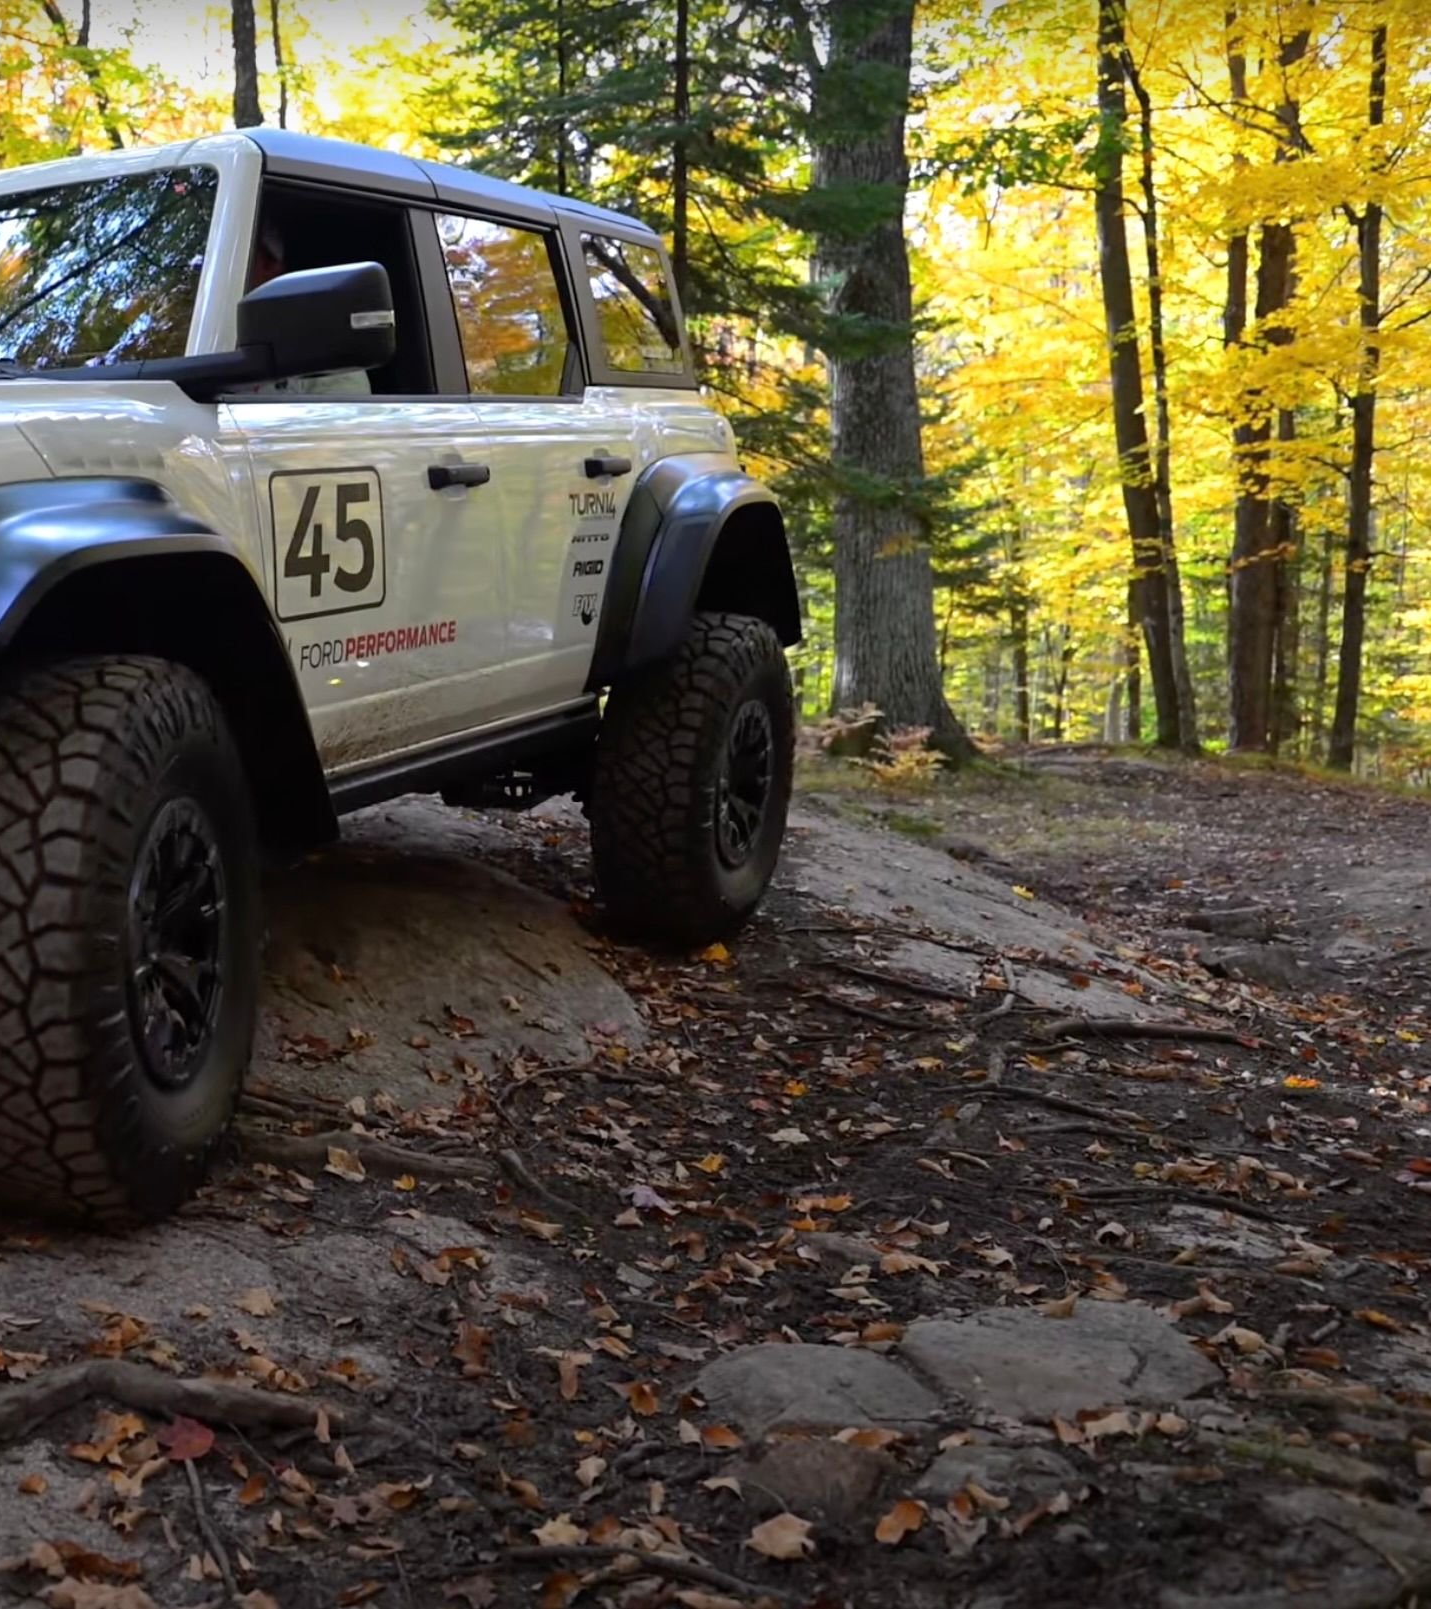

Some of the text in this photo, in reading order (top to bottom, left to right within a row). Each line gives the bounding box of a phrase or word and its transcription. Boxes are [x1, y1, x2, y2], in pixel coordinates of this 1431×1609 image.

[569, 491, 616, 519] TURN14
[284, 483, 374, 597] 45
[572, 559, 603, 577] RIGID
